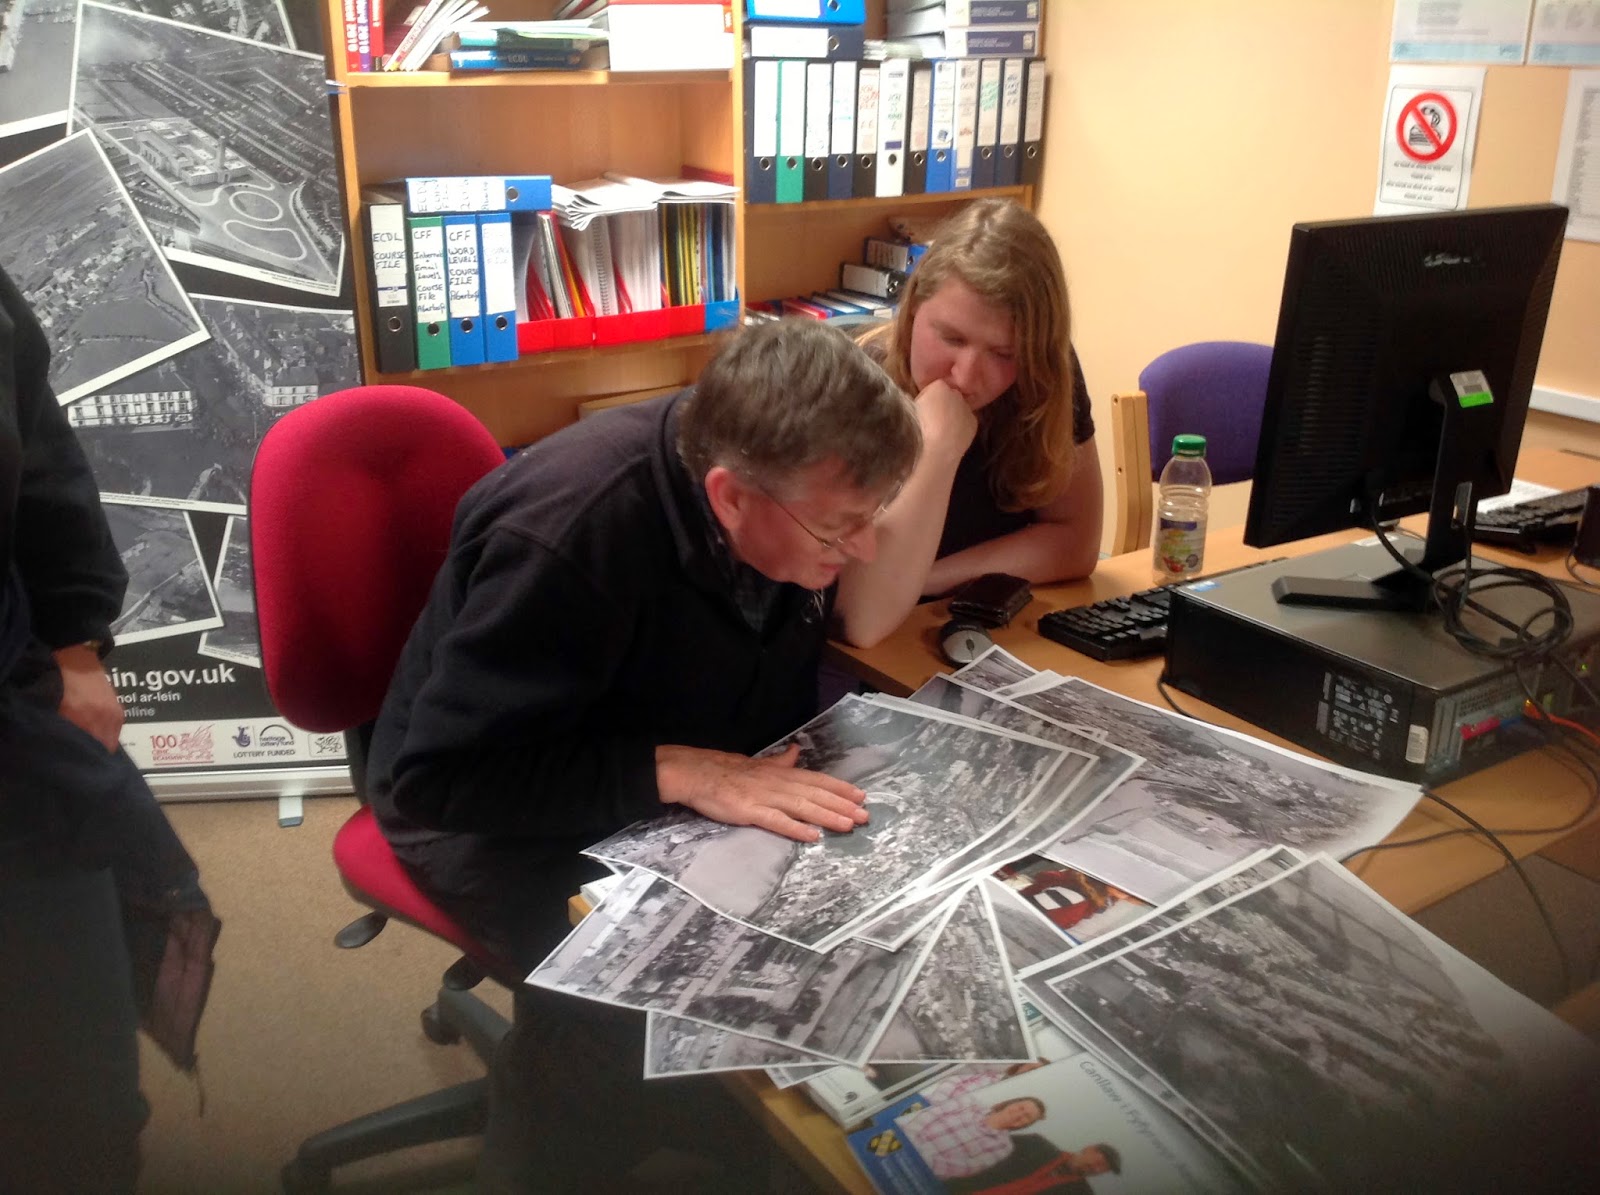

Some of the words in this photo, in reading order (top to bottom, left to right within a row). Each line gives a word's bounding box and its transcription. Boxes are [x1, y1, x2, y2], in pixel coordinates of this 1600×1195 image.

[346, 23, 358, 52] 2010
[358, 25, 370, 54] 2010
[373, 231, 403, 242] ECDL
[413, 230, 432, 240] CFF
[449, 230, 471, 241] CFF
[374, 250, 406, 260] COURSE
[448, 247, 475, 255] WORD
[375, 260, 401, 270] FILE
[449, 277, 472, 286] FILE
[105, 663, 236, 691] in.gov.uk
[116, 692, 137, 704] nol
[140, 690, 181, 703] ar-lein
[124, 706, 155, 718] nline
[150, 734, 177, 749] 100
[233, 750, 265, 759] LOTTERY
[267, 748, 296, 757] FUNDED
[1079, 1061, 1122, 1102] Canllaw
